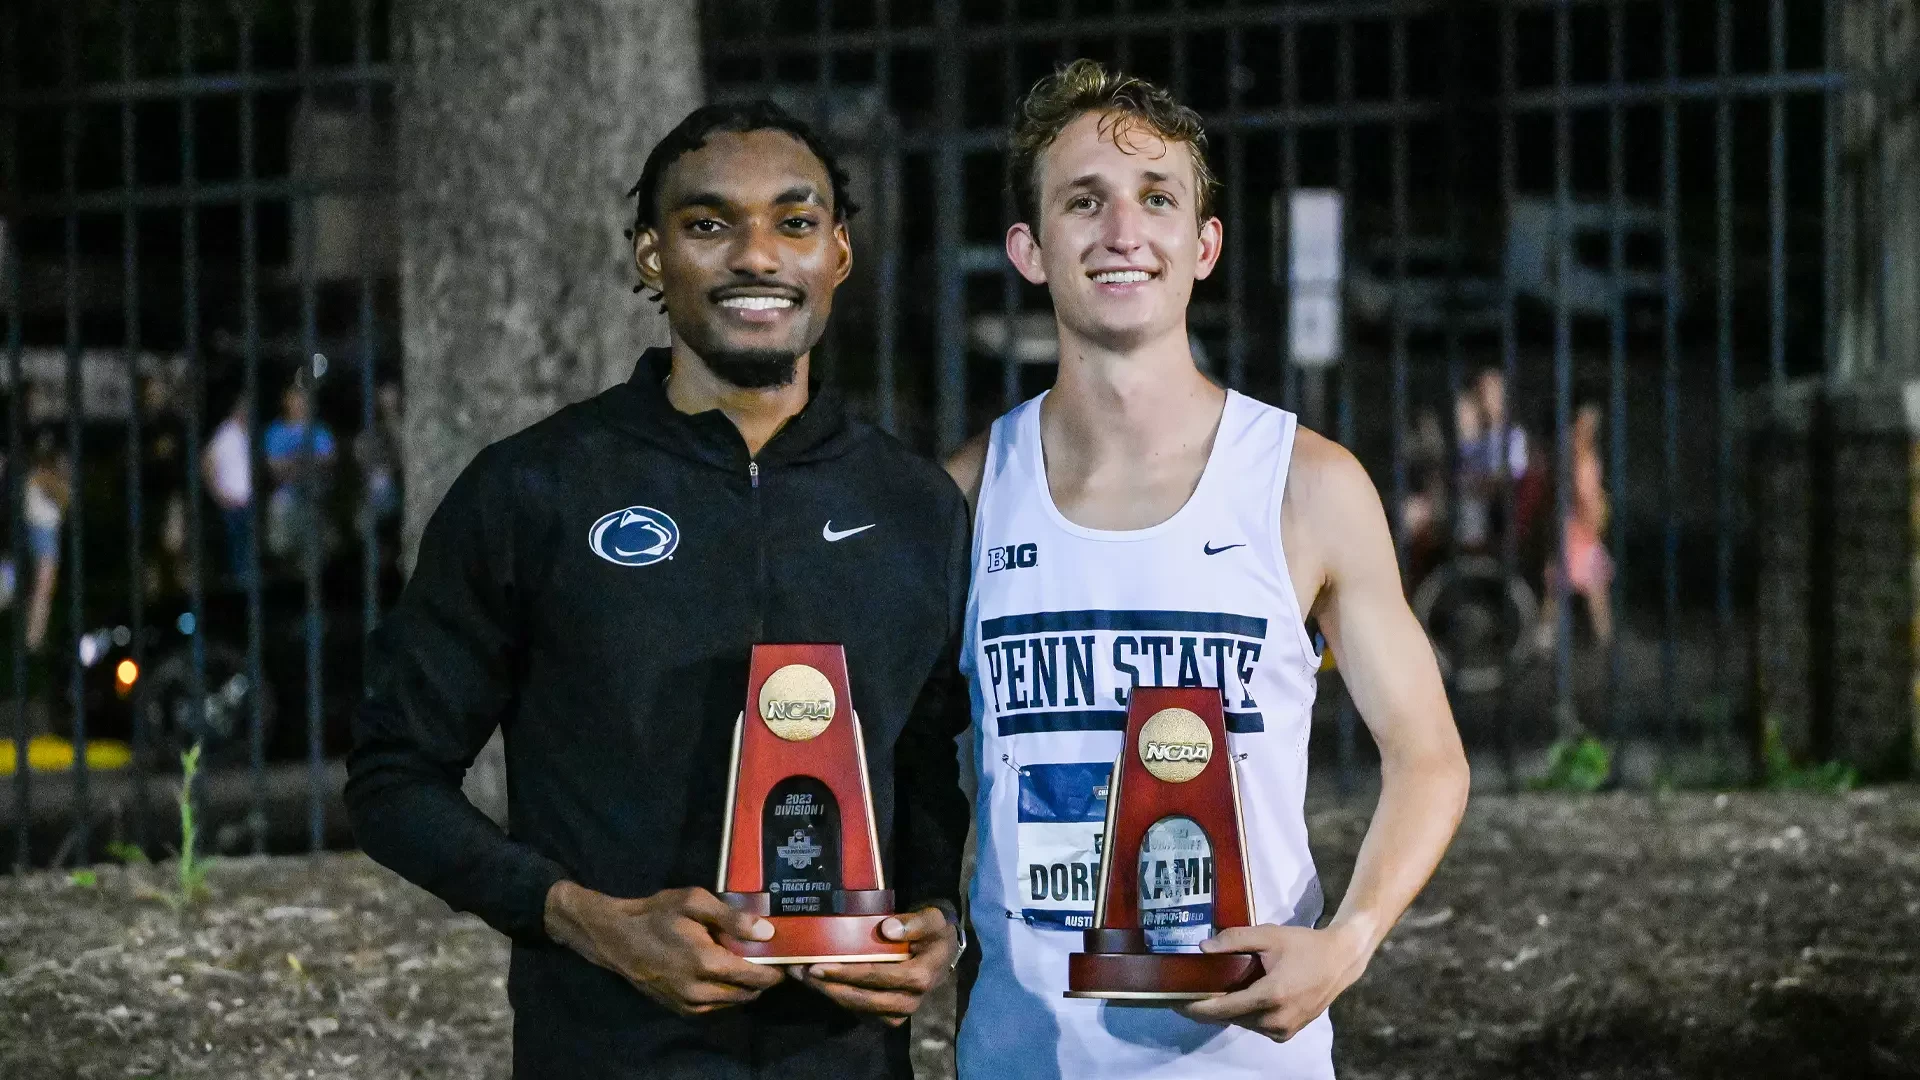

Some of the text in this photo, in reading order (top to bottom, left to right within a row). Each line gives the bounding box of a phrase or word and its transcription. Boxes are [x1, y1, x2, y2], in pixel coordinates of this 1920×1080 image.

[983, 635, 1263, 713] PENN STATE
[766, 699, 831, 720] NCAA
[1145, 741, 1208, 762] NCAA
[785, 793, 813, 805] 2023
[774, 804, 818, 816] DIVISION
[782, 882, 805, 891] TRACK
[811, 881, 831, 891] FIELD
[1065, 915, 1093, 928] AUSTI
